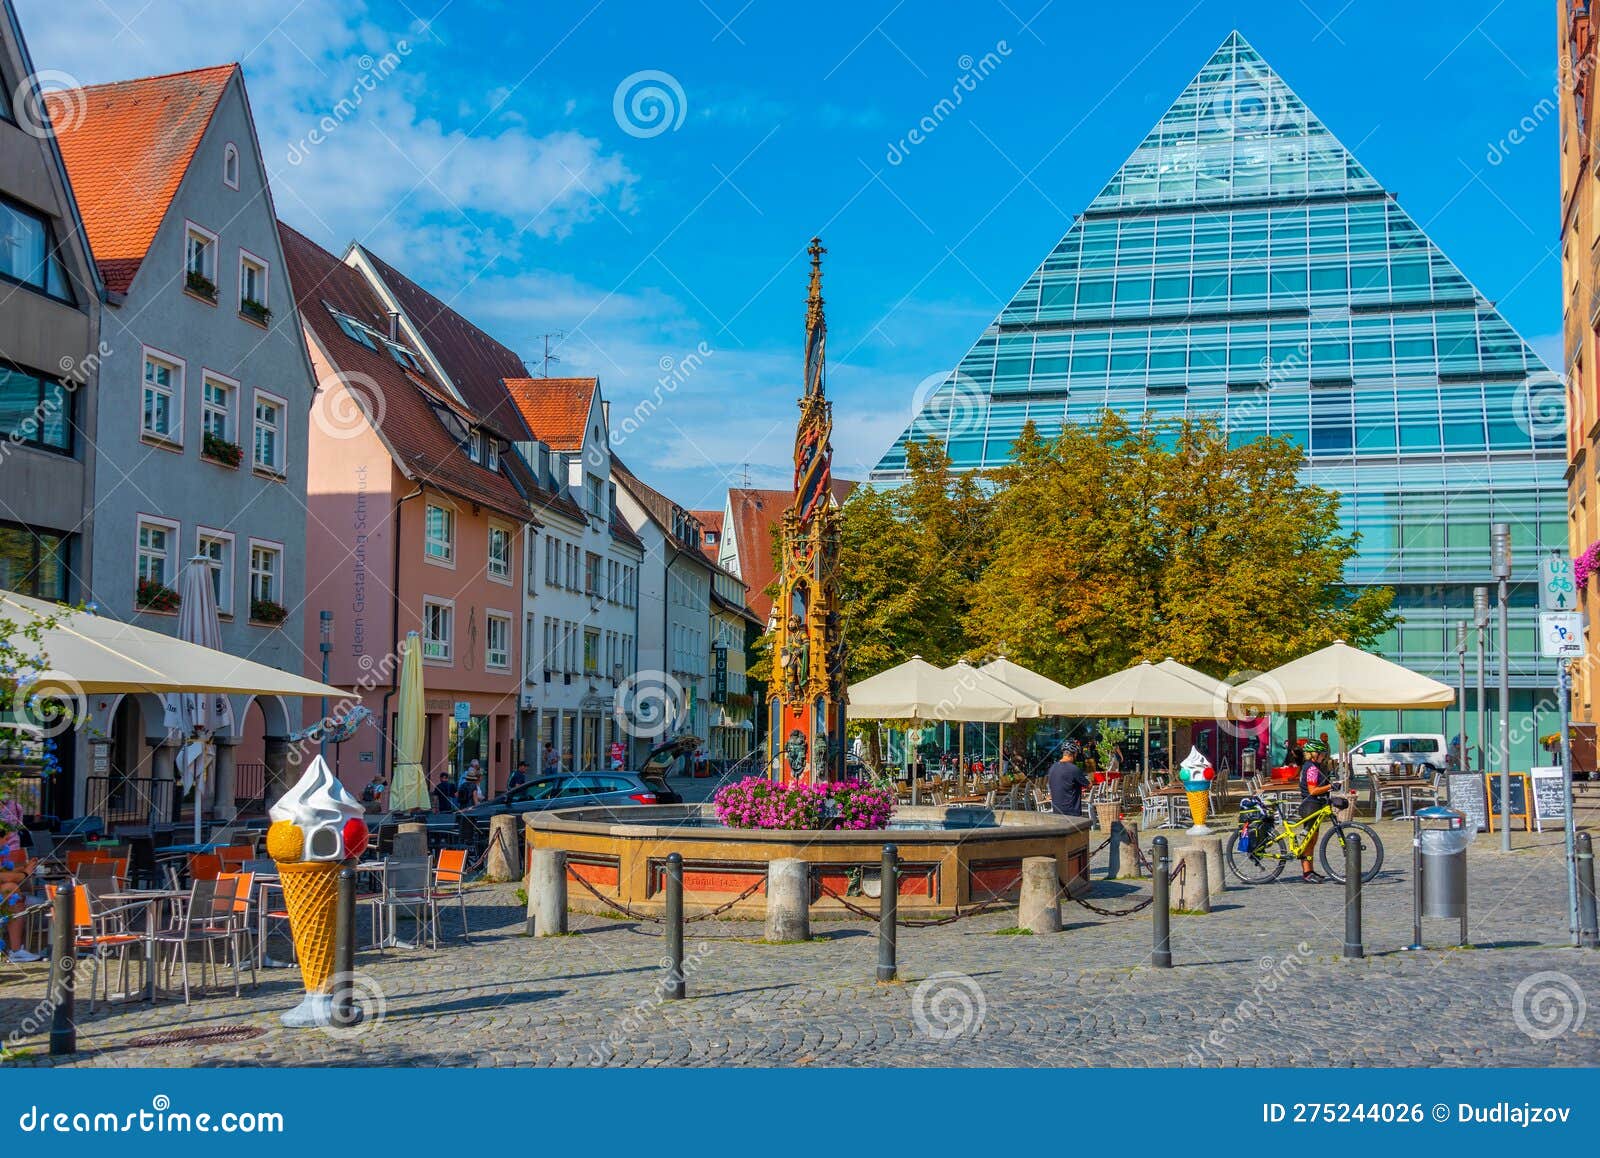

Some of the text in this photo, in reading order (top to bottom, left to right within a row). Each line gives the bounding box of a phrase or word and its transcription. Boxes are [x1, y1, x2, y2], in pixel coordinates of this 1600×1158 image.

[352, 465, 369, 657] Ideen Gestaltung Schmuck
[717, 649, 726, 702] HOTEL
